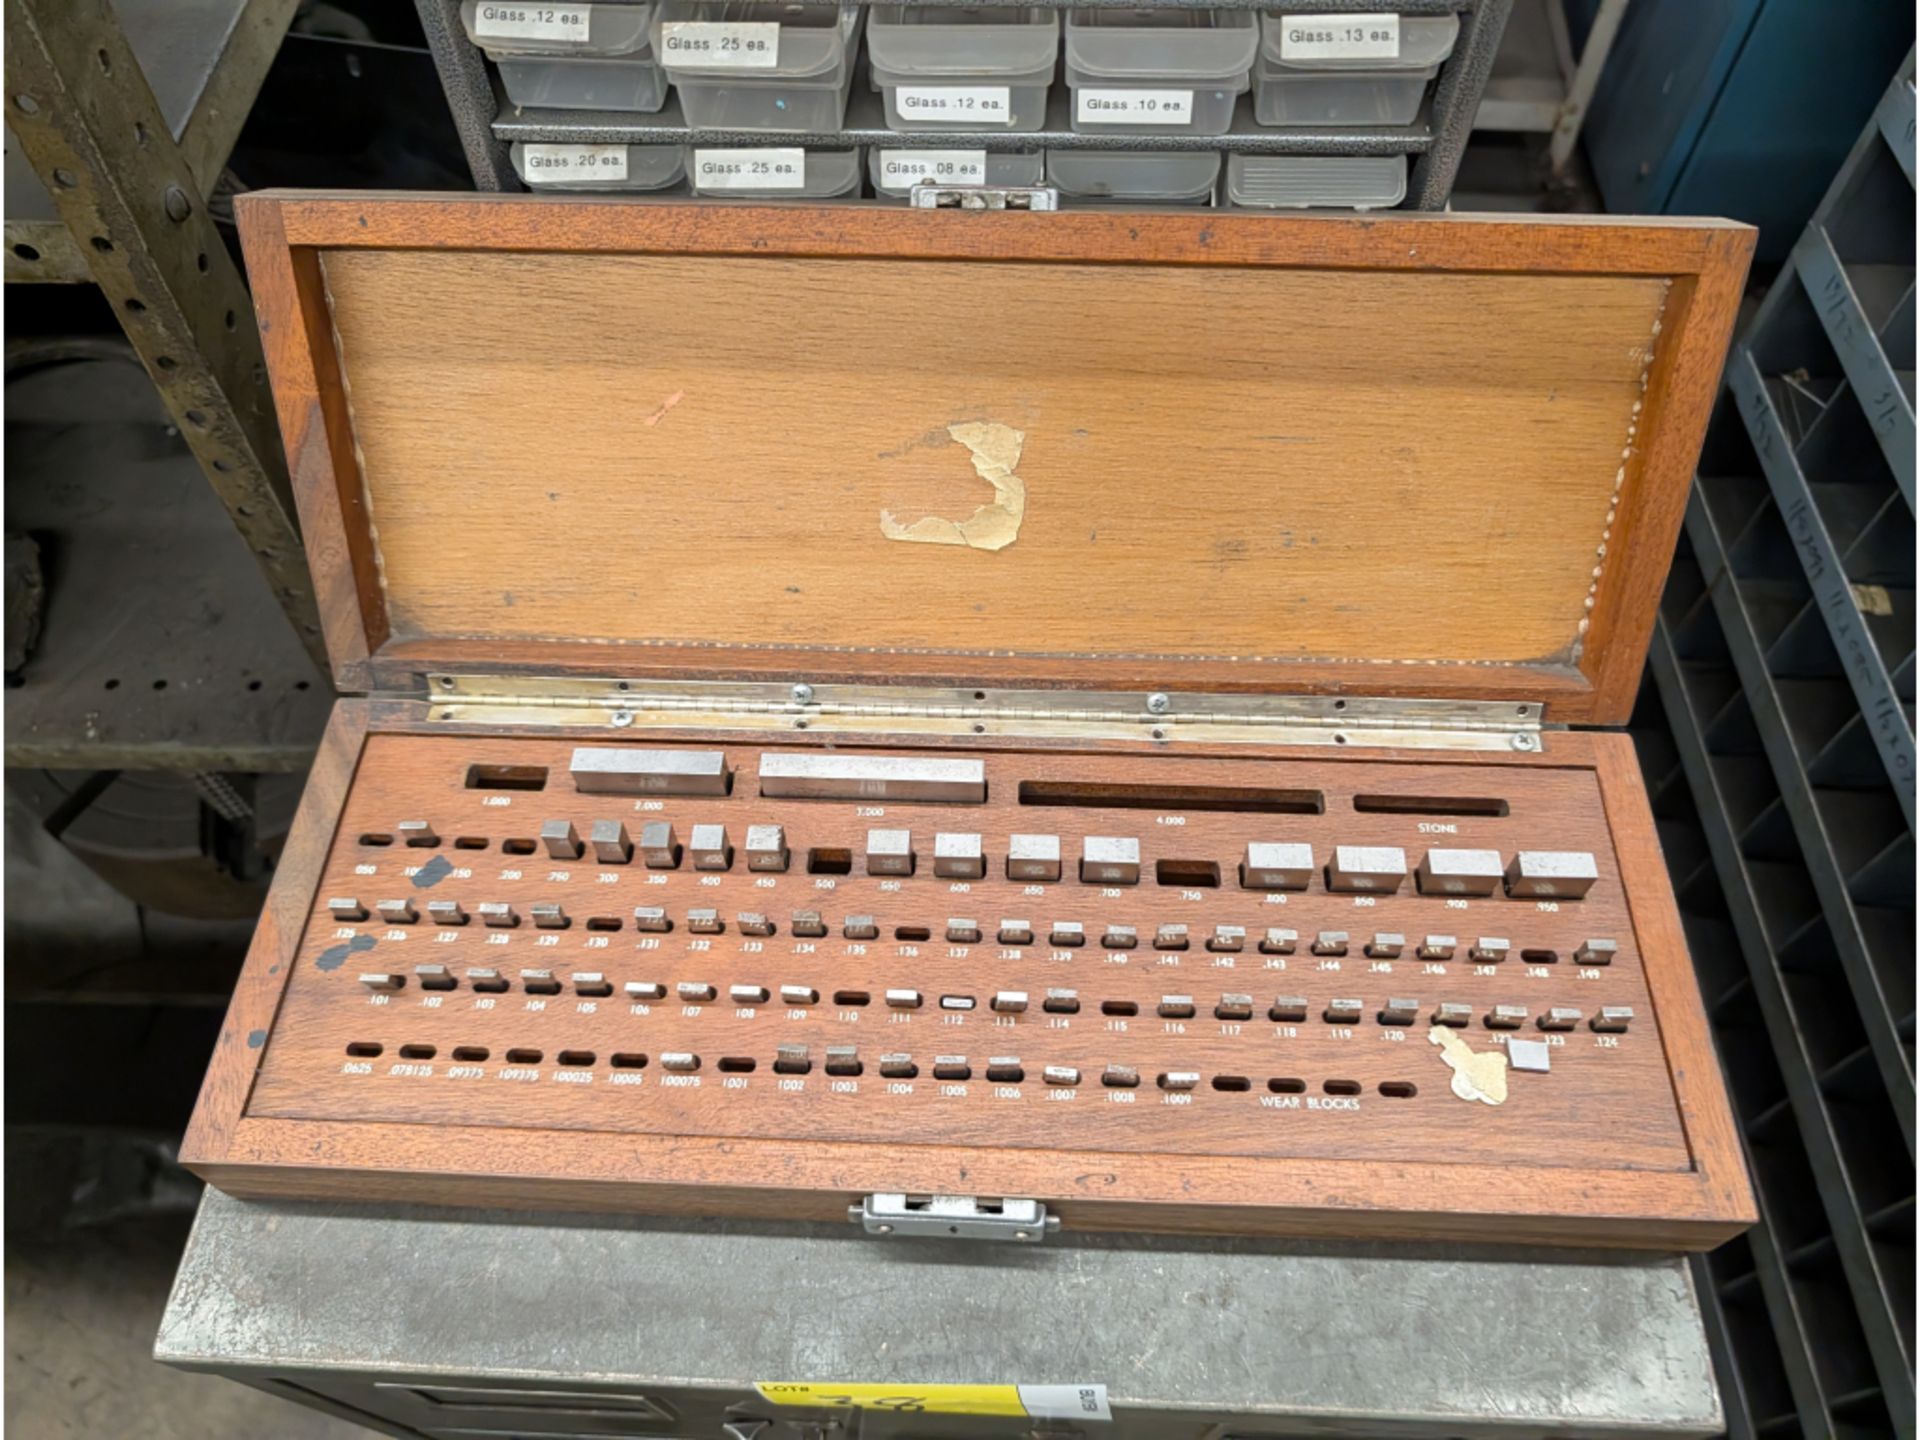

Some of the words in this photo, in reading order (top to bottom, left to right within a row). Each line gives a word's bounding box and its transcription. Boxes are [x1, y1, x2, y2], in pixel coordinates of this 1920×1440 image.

[482, 7, 526, 22] Glass
[531, 10, 555, 24] .12
[560, 13, 584, 25] ea.
[1288, 28, 1334, 44] Glass
[1339, 28, 1364, 44] .13
[1369, 31, 1394, 43] ea.
[666, 36, 710, 51] Glass
[716, 36, 741, 52] .25
[745, 40, 769, 52] ea.
[904, 96, 947, 109] Glass
[952, 96, 975, 110] .12
[980, 100, 1004, 110] ea.
[1086, 98, 1128, 111] Glass
[1133, 99, 1157, 111] .10
[1162, 102, 1185, 111] ea.
[529, 154, 569, 169] Glass
[574, 153, 597, 168] .20
[600, 156, 624, 167] ea.
[701, 161, 742, 175] Glass
[747, 160, 771, 175] .25
[774, 164, 797, 175] ea.
[885, 160, 927, 175] Glass
[932, 161, 955, 175] .08
[959, 164, 981, 175] ea.
[1417, 822, 1458, 834] STONE
[400, 866, 423, 877] .10
[1259, 1095, 1301, 1109] WEAR
[1306, 1096, 1361, 1111] BLOCKS
